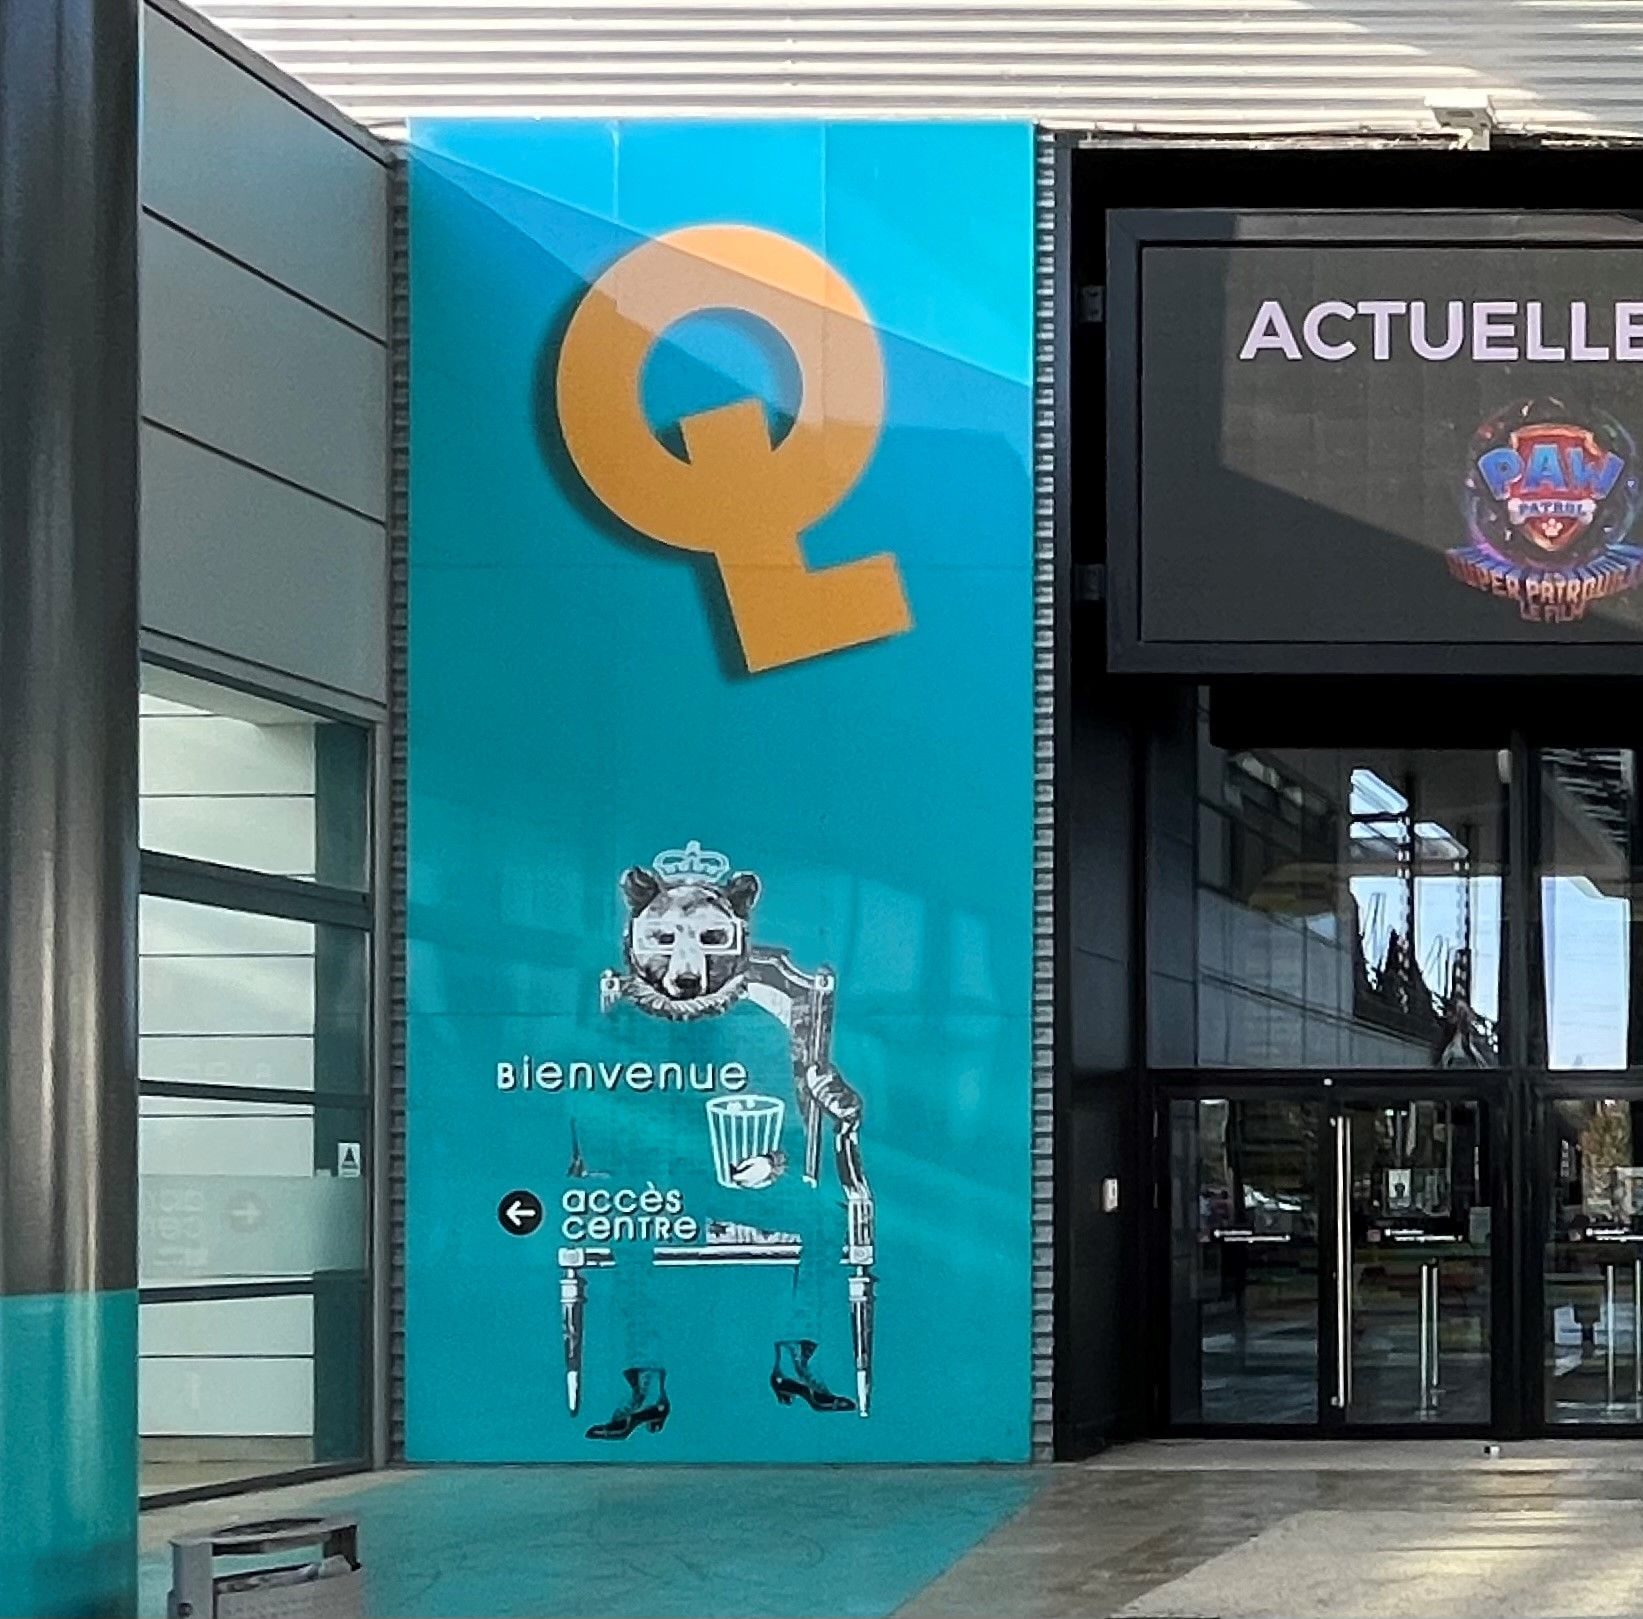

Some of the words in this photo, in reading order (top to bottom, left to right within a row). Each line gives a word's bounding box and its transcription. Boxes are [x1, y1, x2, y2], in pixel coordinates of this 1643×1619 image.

[1477, 443, 1626, 501] PAW
[1518, 502, 1587, 516] PATROL
[496, 1054, 750, 1092] Bienvenue
[561, 1180, 684, 1214] accès
